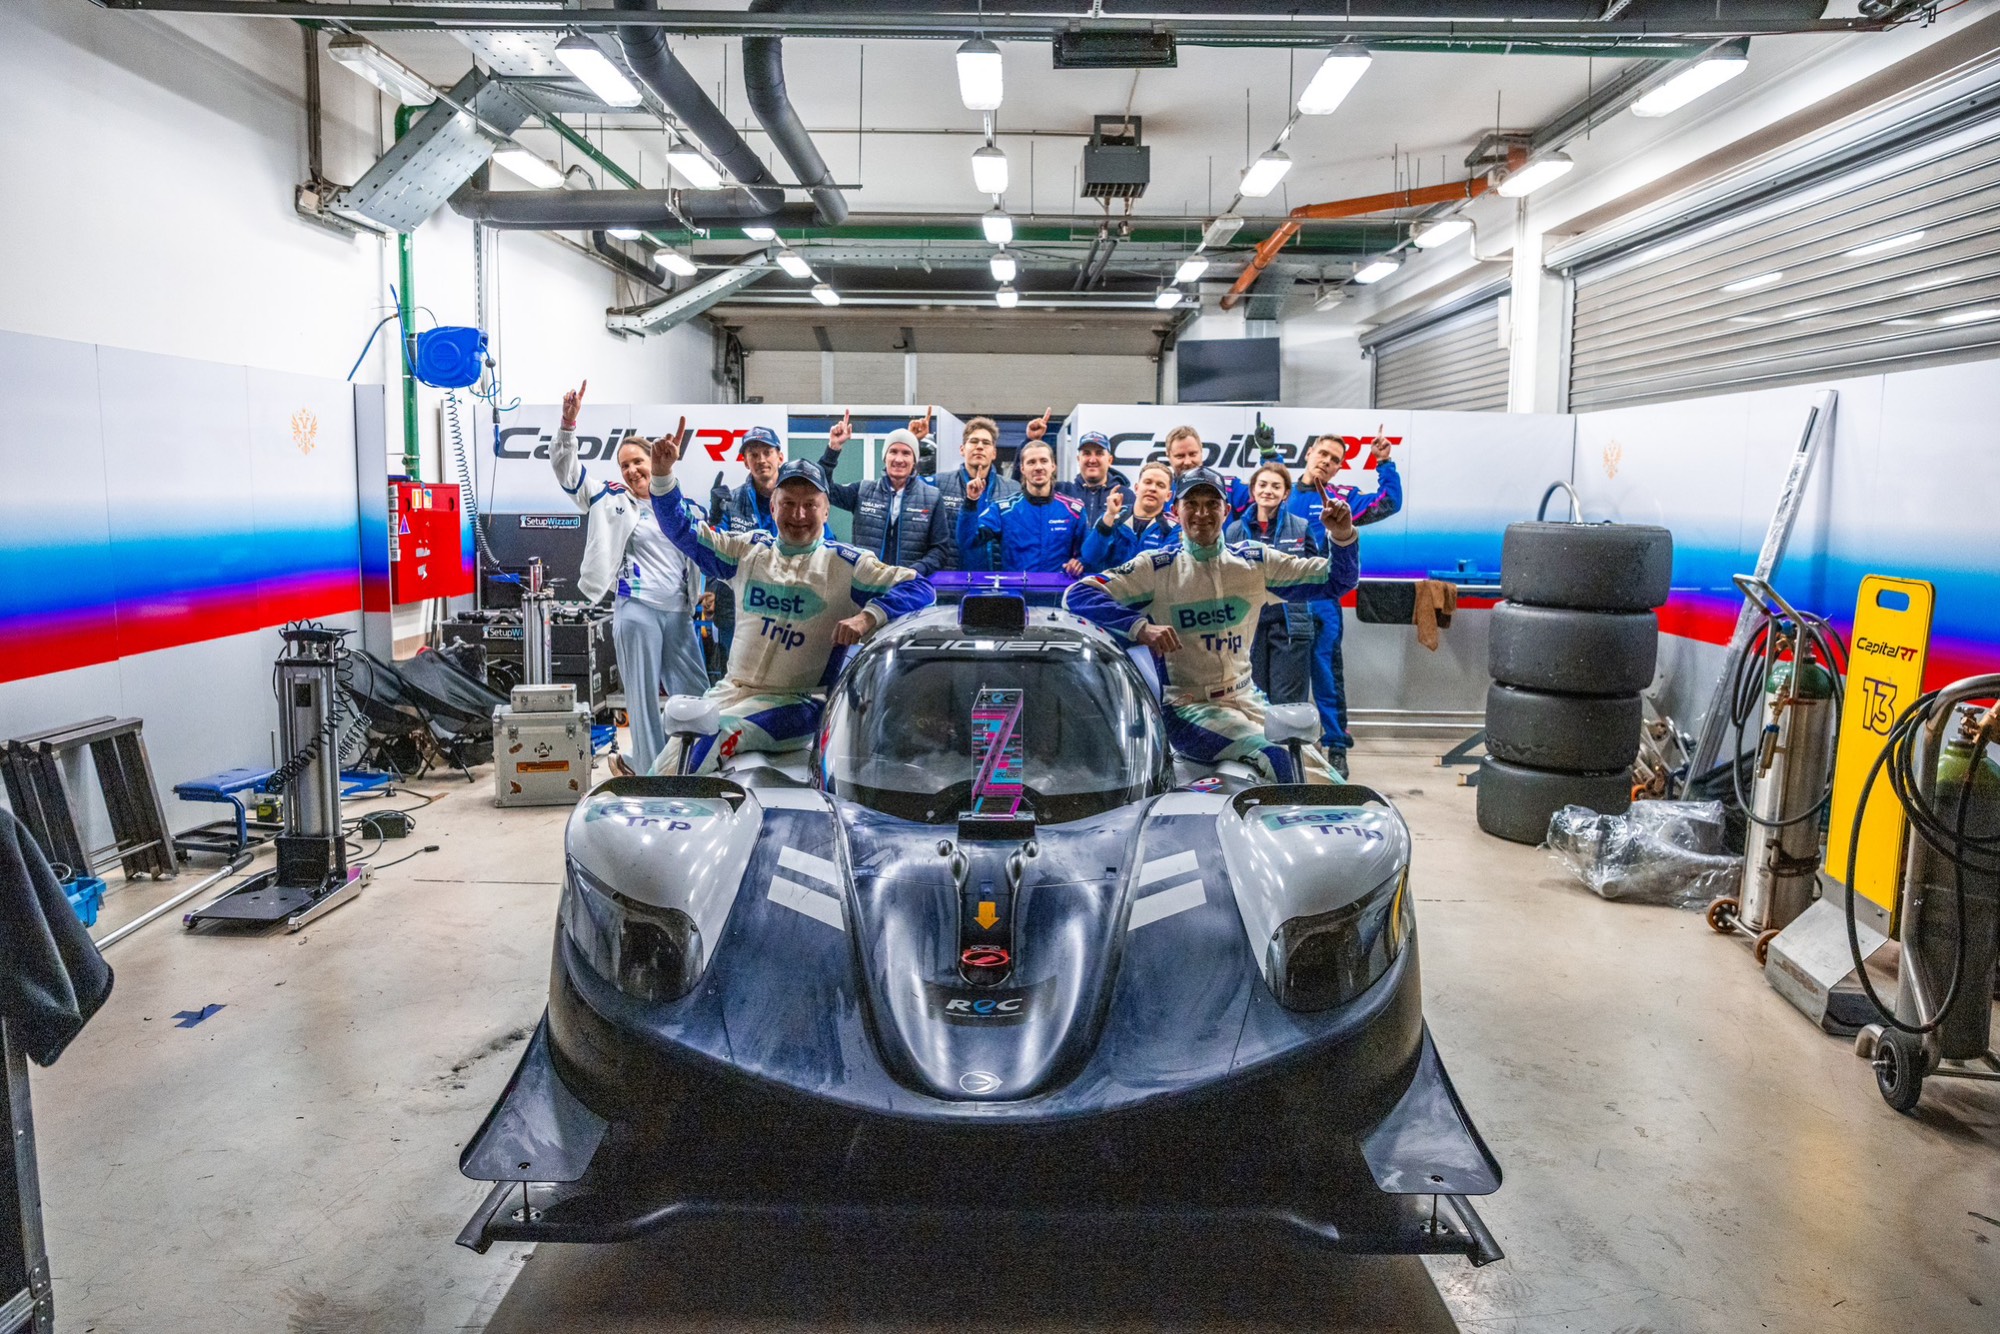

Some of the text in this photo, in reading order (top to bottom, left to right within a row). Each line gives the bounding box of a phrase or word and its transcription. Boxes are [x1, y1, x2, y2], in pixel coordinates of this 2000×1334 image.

[497, 427, 750, 462] CapilR
[526, 517, 579, 527] SetupWizzard
[749, 586, 805, 614] Best
[1178, 603, 1237, 629] Best
[489, 626, 523, 638] SetupWi
[760, 616, 805, 651] Trip
[1200, 631, 1242, 654] Trip
[1856, 636, 1919, 662] CapitalRT
[1862, 676, 1898, 736] 13
[600, 802, 690, 816] Bst
